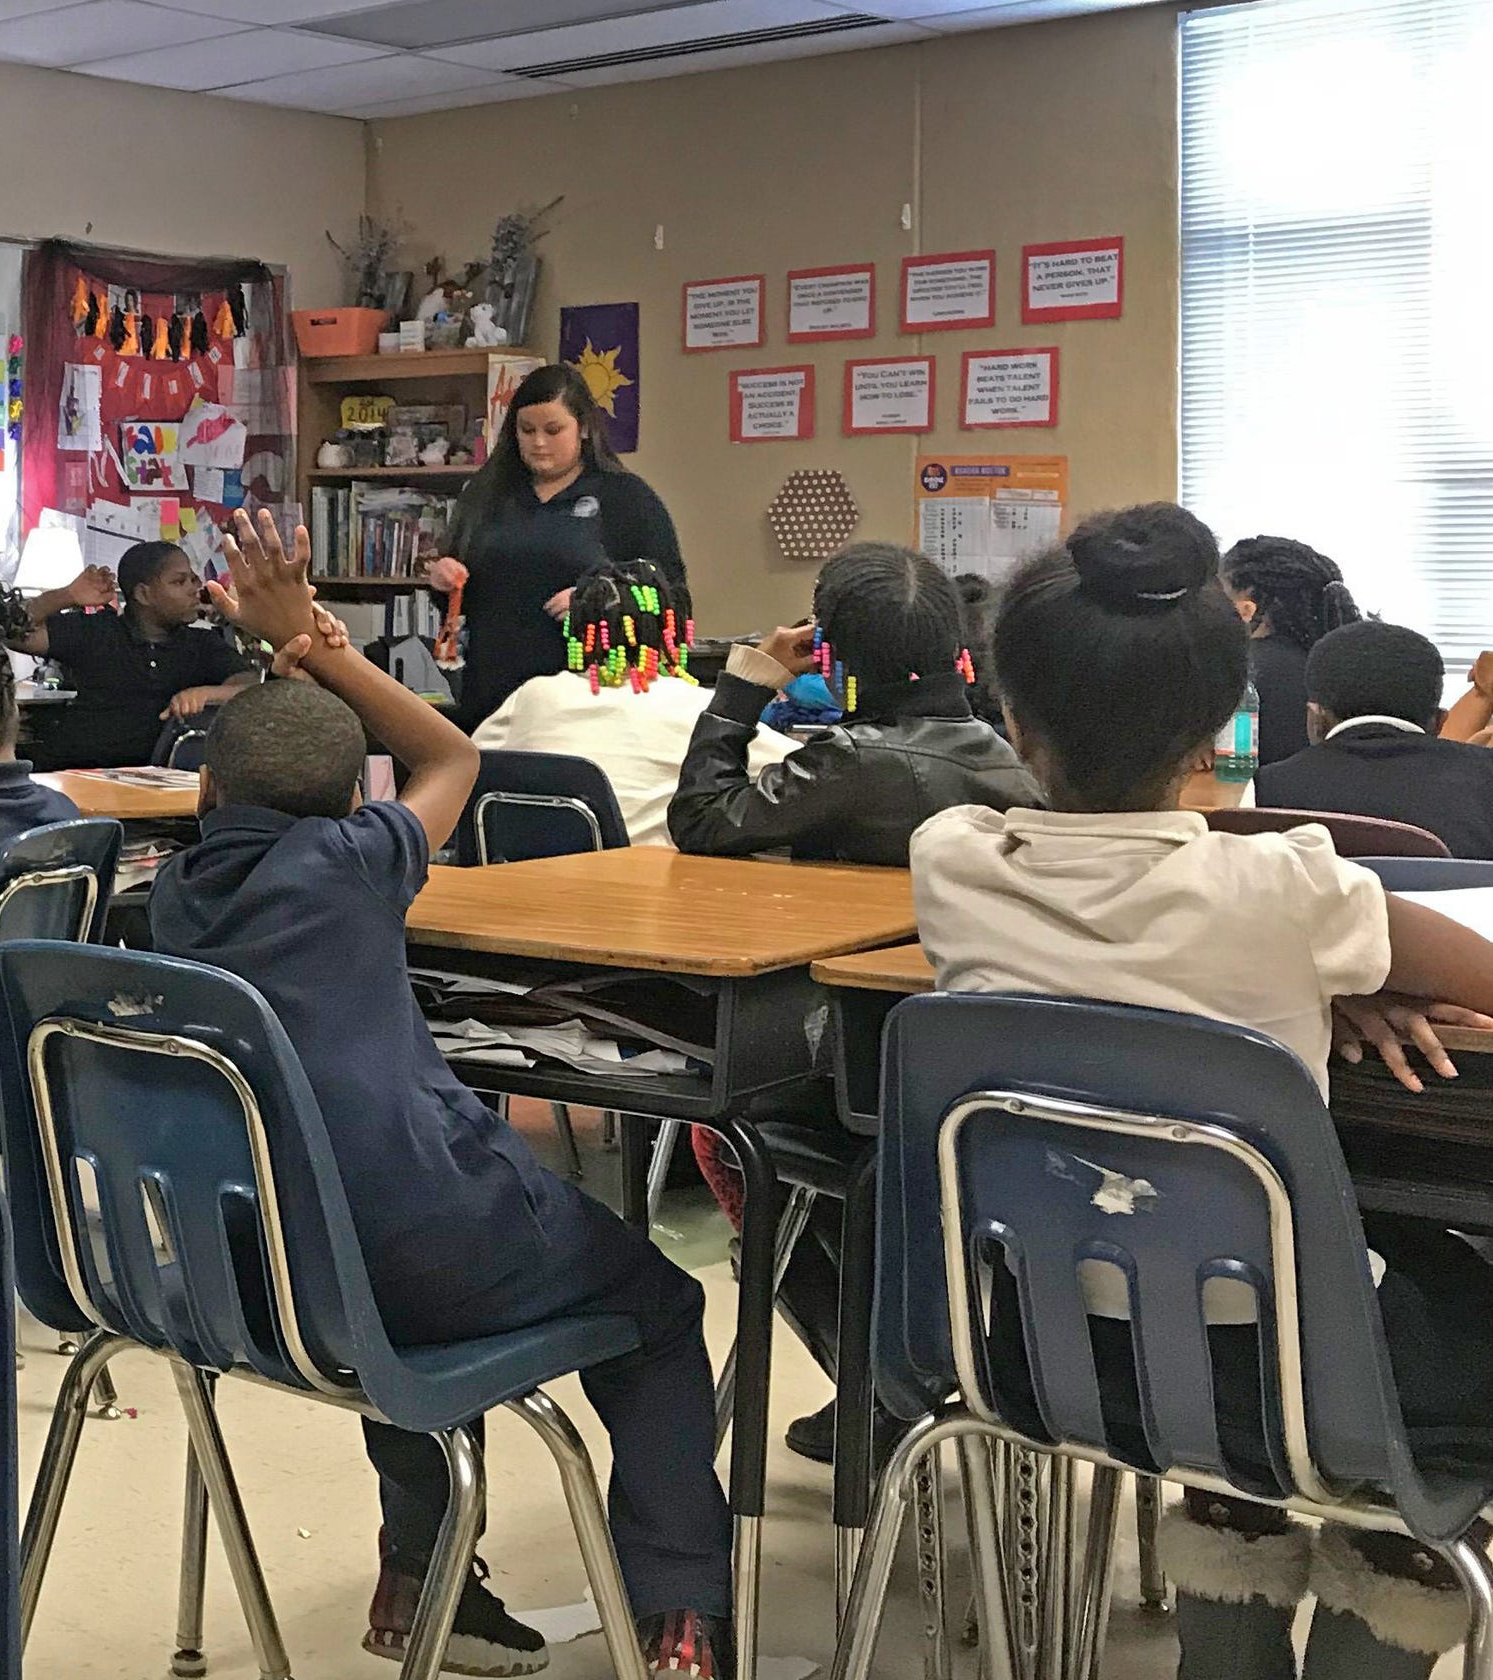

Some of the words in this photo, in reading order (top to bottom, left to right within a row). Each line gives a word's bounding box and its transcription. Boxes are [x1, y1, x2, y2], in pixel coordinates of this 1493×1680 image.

[1051, 258, 1079, 268] HARD
[1080, 256, 1093, 264] TO
[1094, 253, 1118, 263] BEAT
[1087, 265, 1112, 275] THAT
[1032, 282, 1064, 292] NEVER
[1065, 279, 1094, 289] GIVES
[1010, 361, 1038, 370] WORK
[908, 368, 926, 376] WIN
[976, 375, 1006, 383] BEATS
[1006, 372, 1042, 381] TALENT
[880, 381, 898, 389] YOU
[898, 380, 928, 388] LEARN
[976, 386, 1005, 394] WHEN
[1006, 383, 1041, 392] TALENT
[859, 393, 880, 401] HOW
[968, 397, 994, 405] FAILS
[995, 396, 1007, 404] TO
[1009, 395, 1022, 403] DO
[1023, 394, 1050, 402] HARD
[347, 406, 390, 423] 2014
